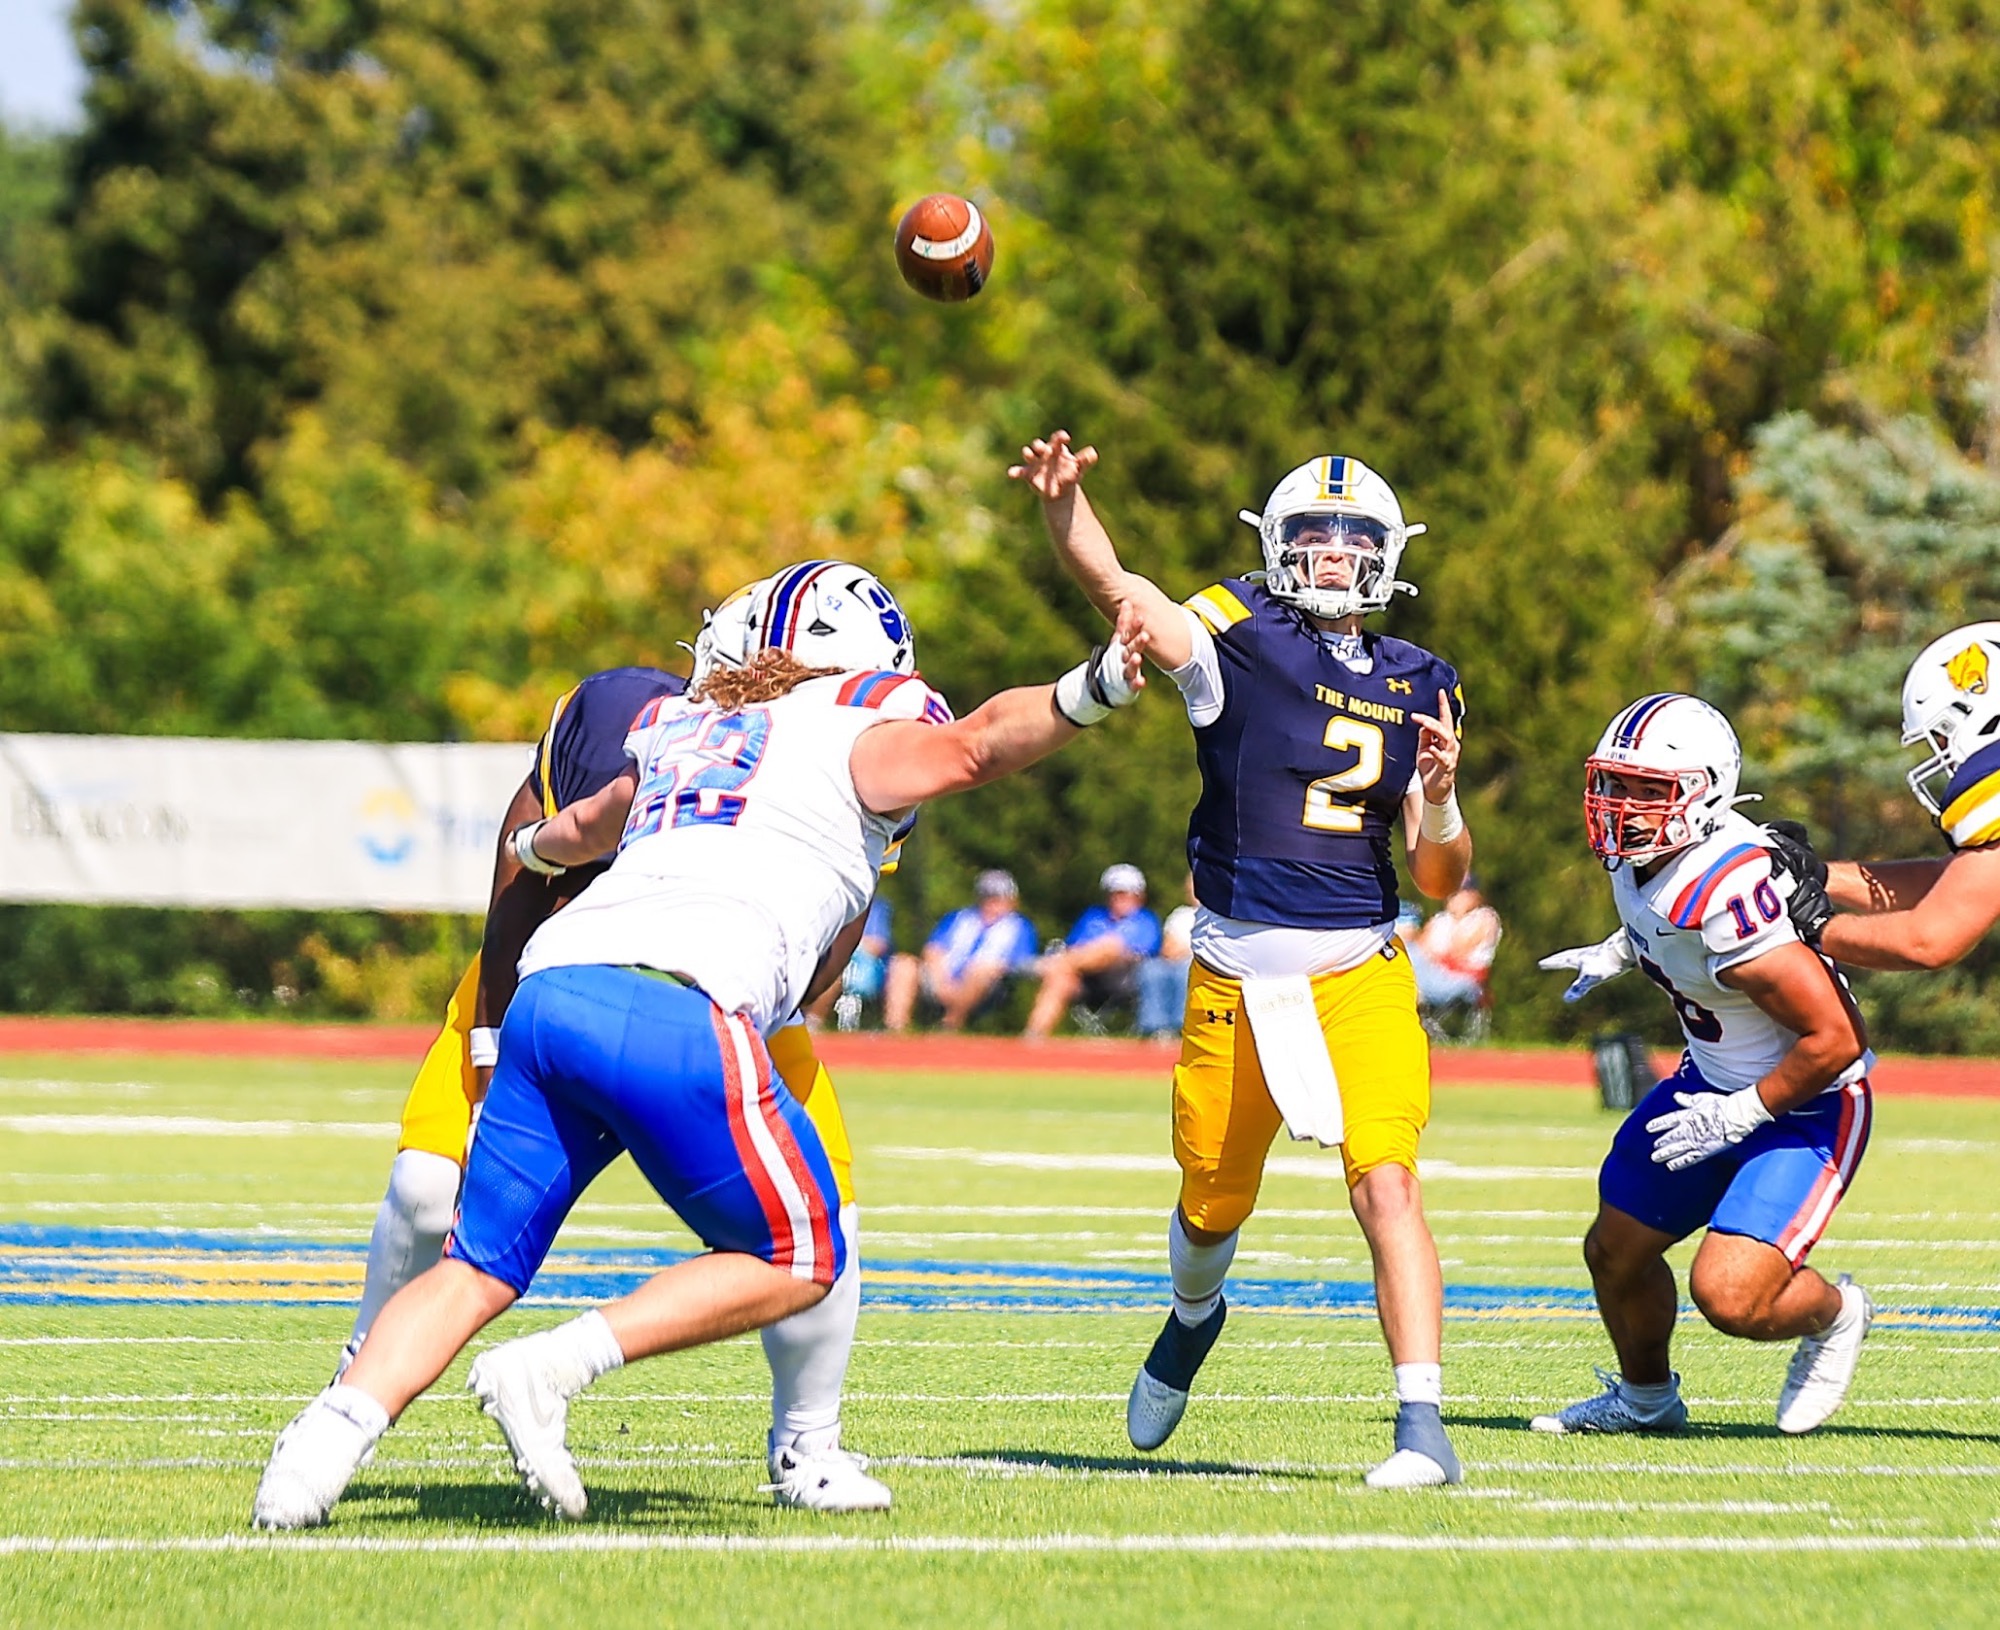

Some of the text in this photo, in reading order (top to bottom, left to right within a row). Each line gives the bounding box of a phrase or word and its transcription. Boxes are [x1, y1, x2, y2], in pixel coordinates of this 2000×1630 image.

[824, 595, 843, 611] 52
[1315, 683, 1405, 725] THE MOUNT
[617, 707, 773, 854] 52
[1302, 714, 1386, 833] 2
[1726, 875, 1782, 940] 10
